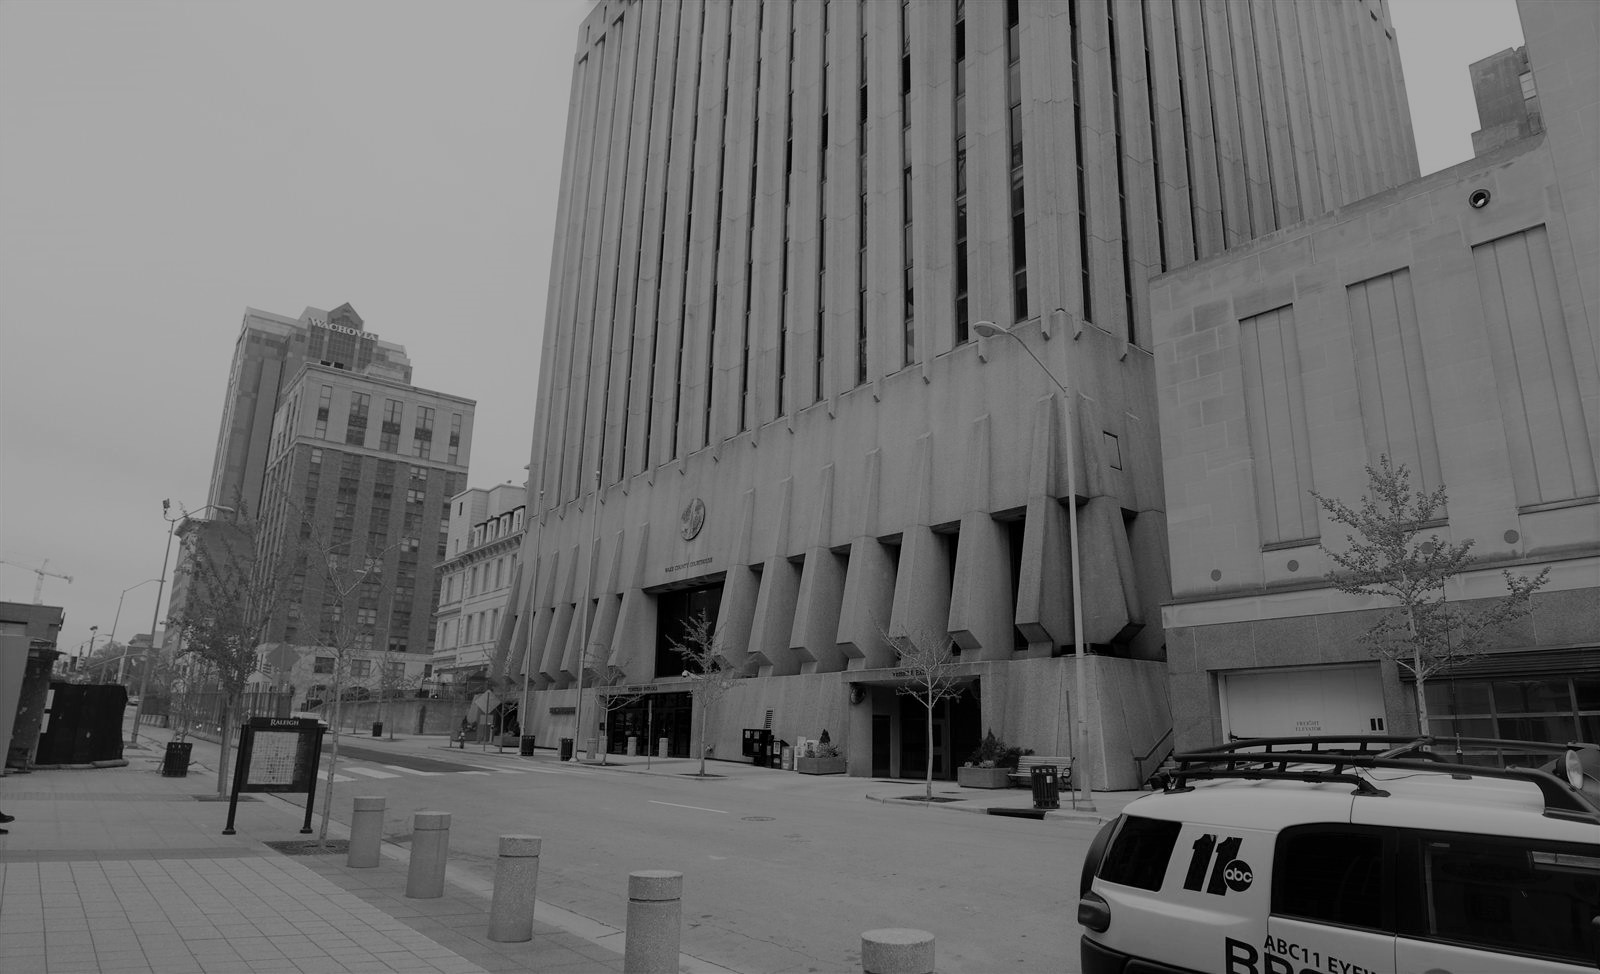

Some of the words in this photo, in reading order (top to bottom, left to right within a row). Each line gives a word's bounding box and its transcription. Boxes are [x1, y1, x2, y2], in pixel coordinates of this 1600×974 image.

[309, 317, 377, 341] WACHOVIA
[1183, 833, 1243, 896] 11
[1225, 867, 1253, 884] abc
[1264, 935, 1320, 968] ABC11
[1328, 956, 1376, 974] EYE
